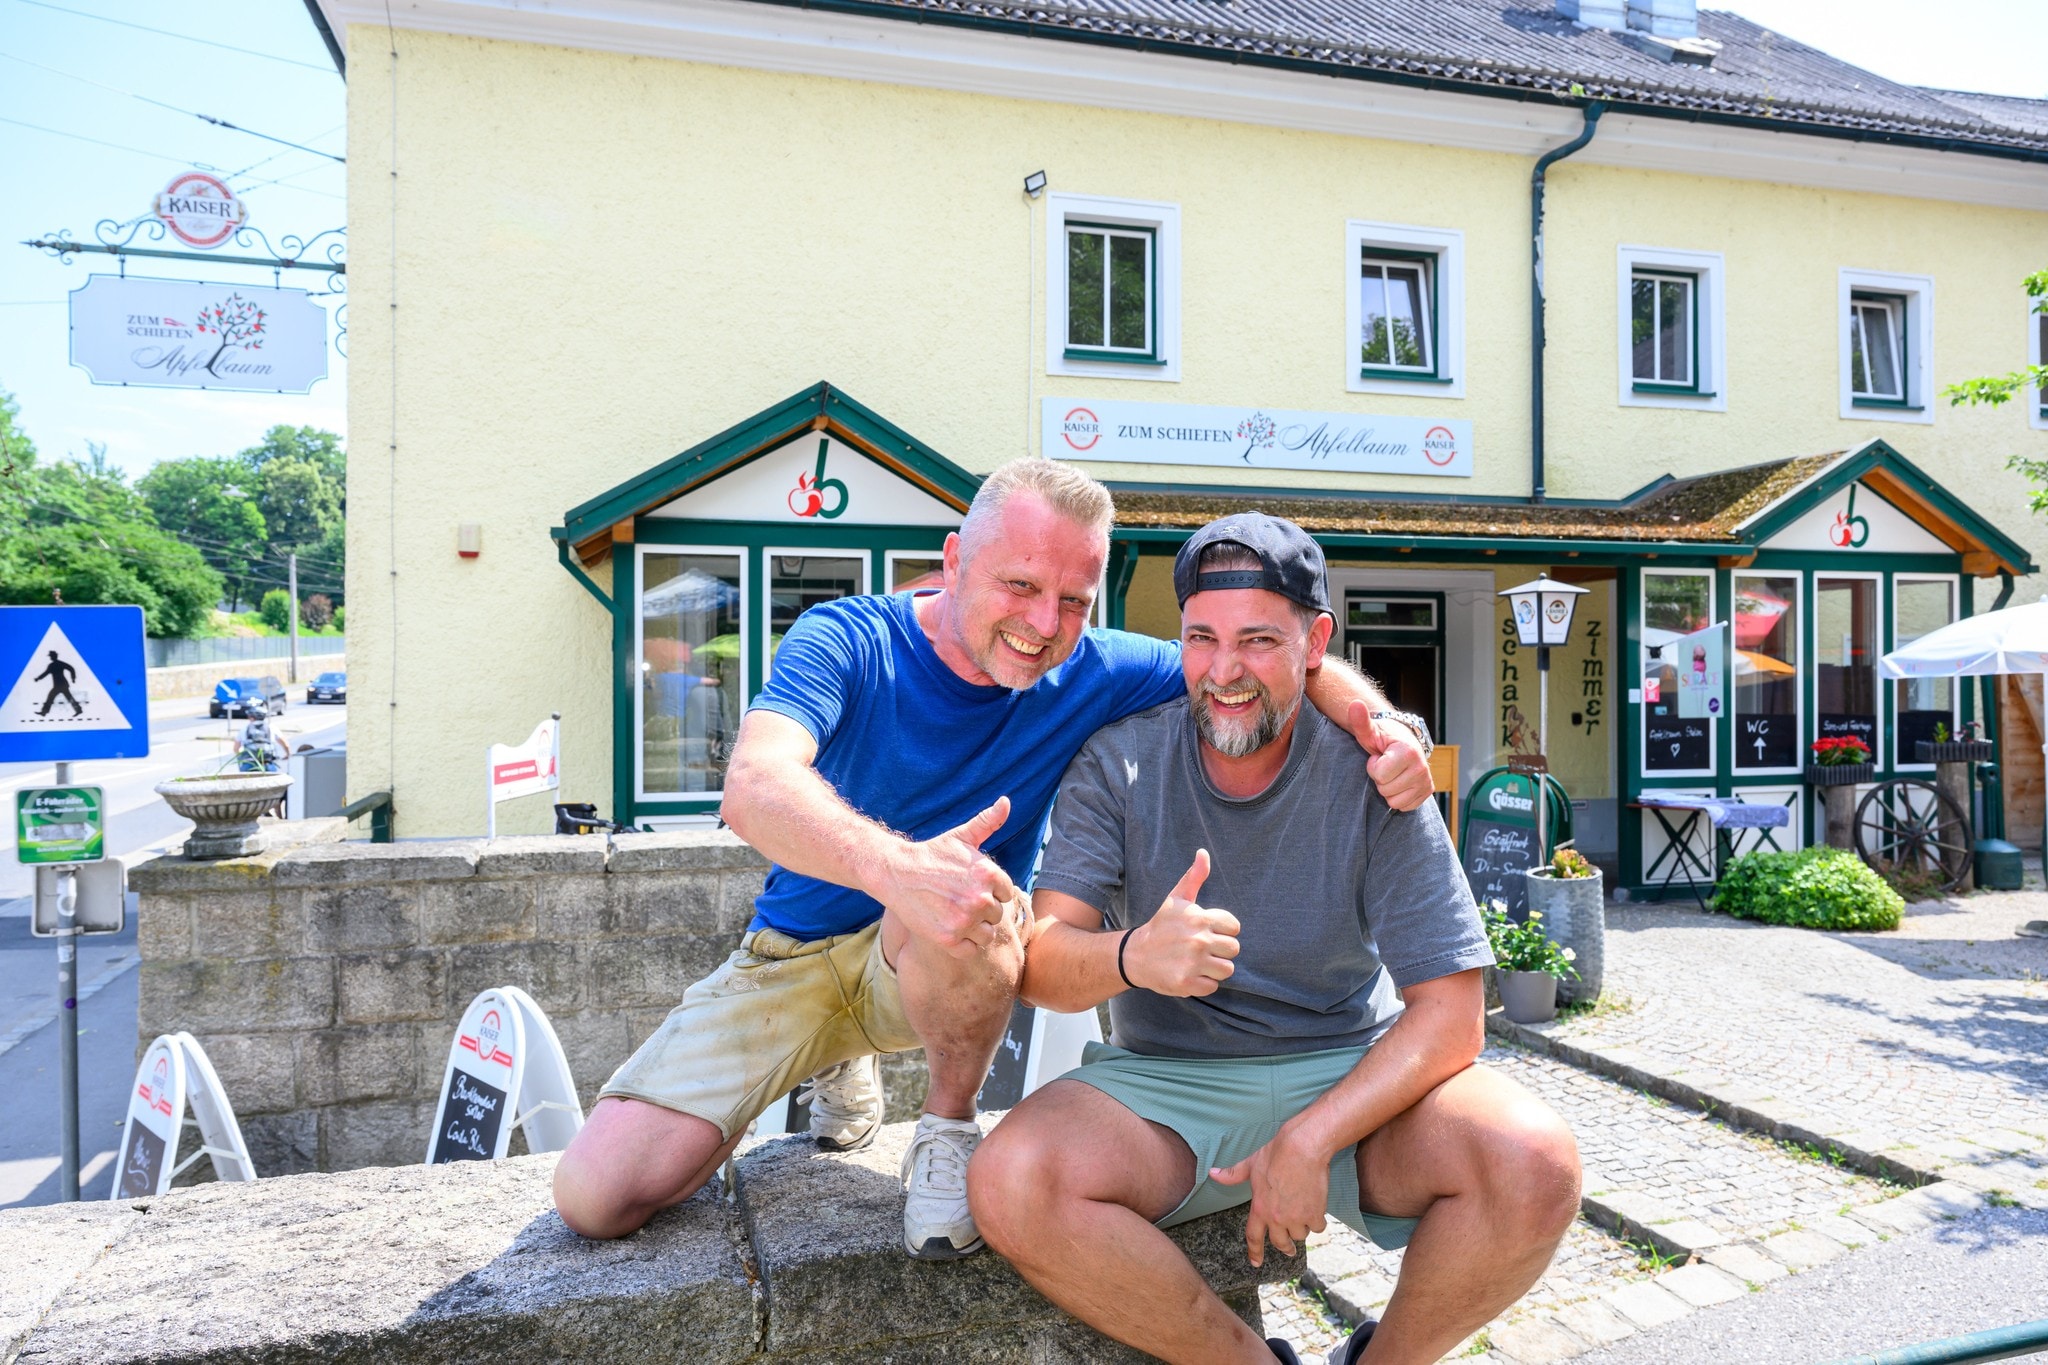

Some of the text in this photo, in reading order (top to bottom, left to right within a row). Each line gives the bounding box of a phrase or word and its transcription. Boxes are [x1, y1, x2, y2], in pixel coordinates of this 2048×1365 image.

[169, 197, 231, 217] KAISER
[127, 314, 160, 326] ZUM
[127, 327, 194, 339] SCHIEFEN
[1064, 422, 1099, 433] KAISER
[1118, 422, 1410, 459] ZUM SCHIEFEN Apfelbaum
[1424, 440, 1455, 450] KAISER
[1746, 720, 1769, 734] WC
[1489, 787, 1534, 811] Gösser
[1487, 878, 1503, 891] ab
